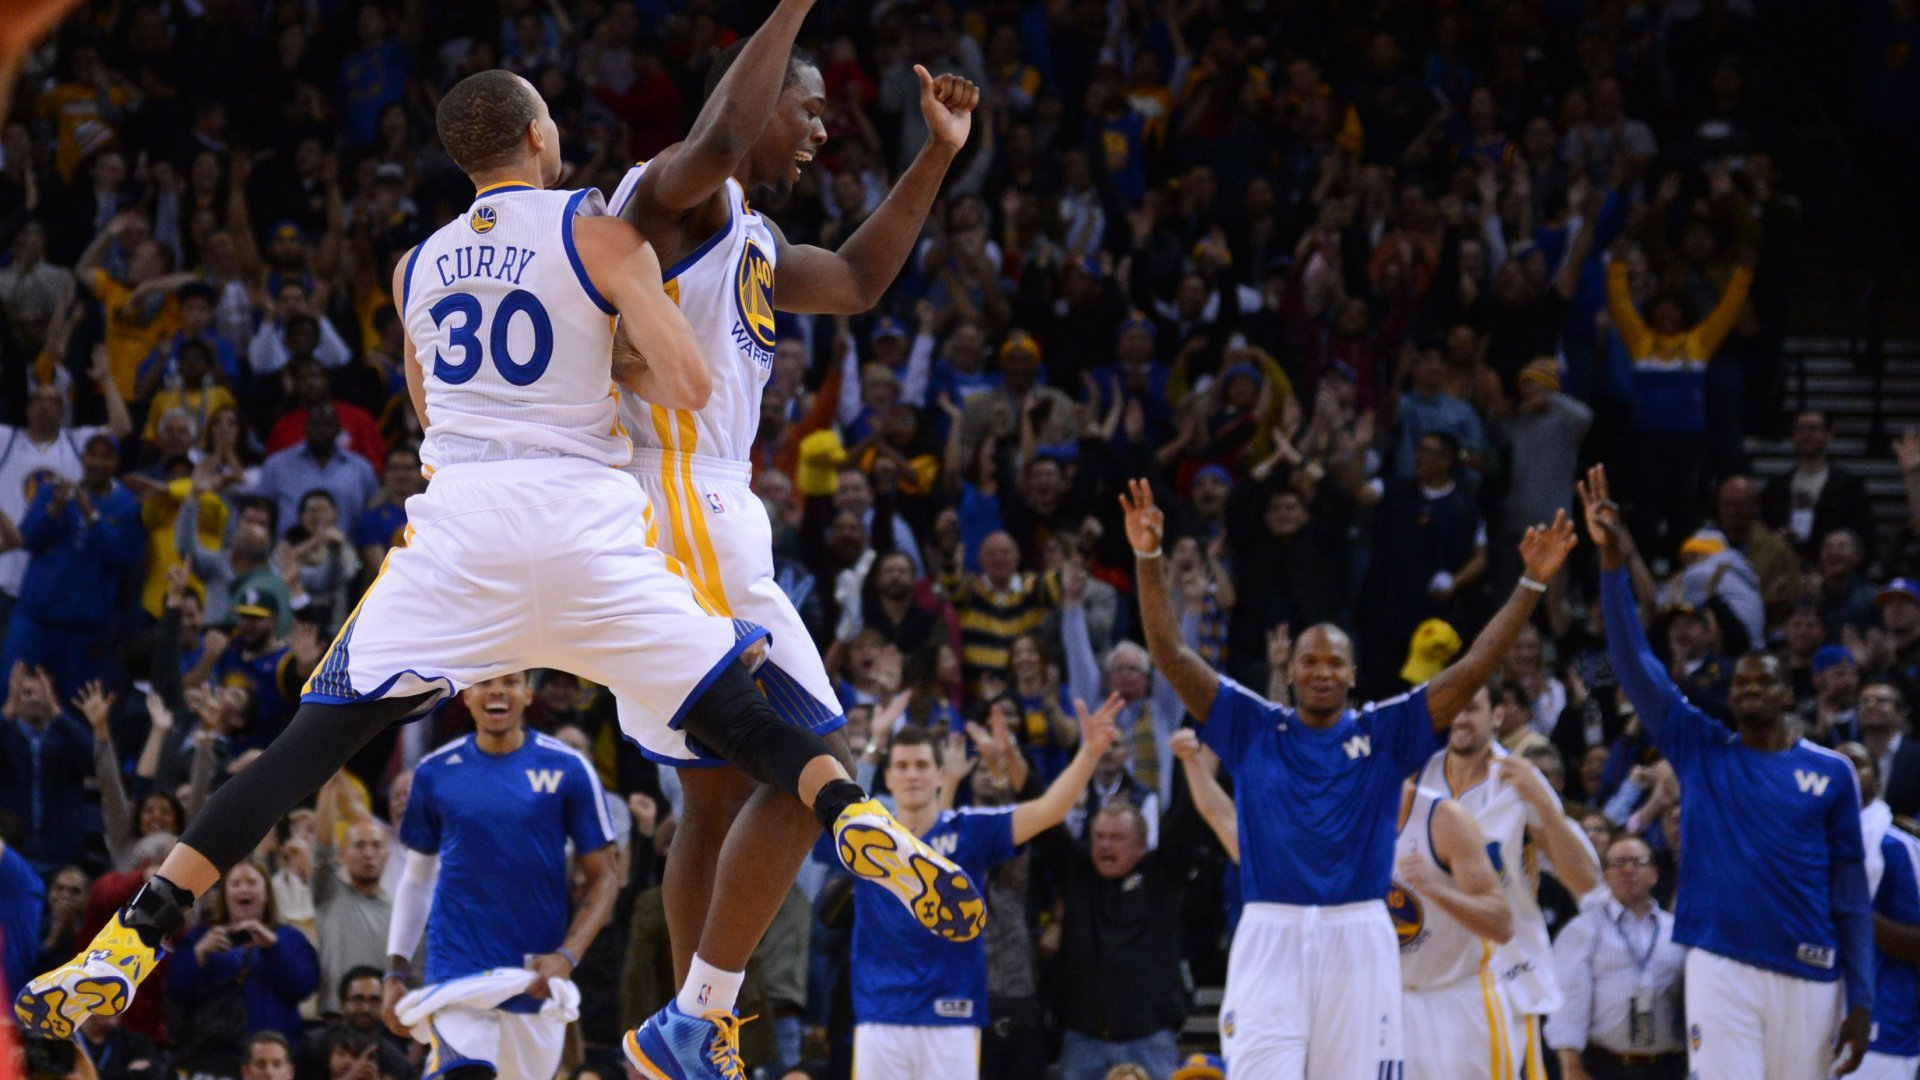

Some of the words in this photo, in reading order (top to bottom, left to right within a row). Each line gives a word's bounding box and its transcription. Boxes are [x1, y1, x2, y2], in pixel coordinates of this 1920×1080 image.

[436, 245, 536, 287] CURRY
[755, 255, 772, 289] 40
[428, 289, 553, 387] 30
[1342, 735, 1372, 761] W
[525, 769, 565, 794] W
[1793, 769, 1831, 797] W
